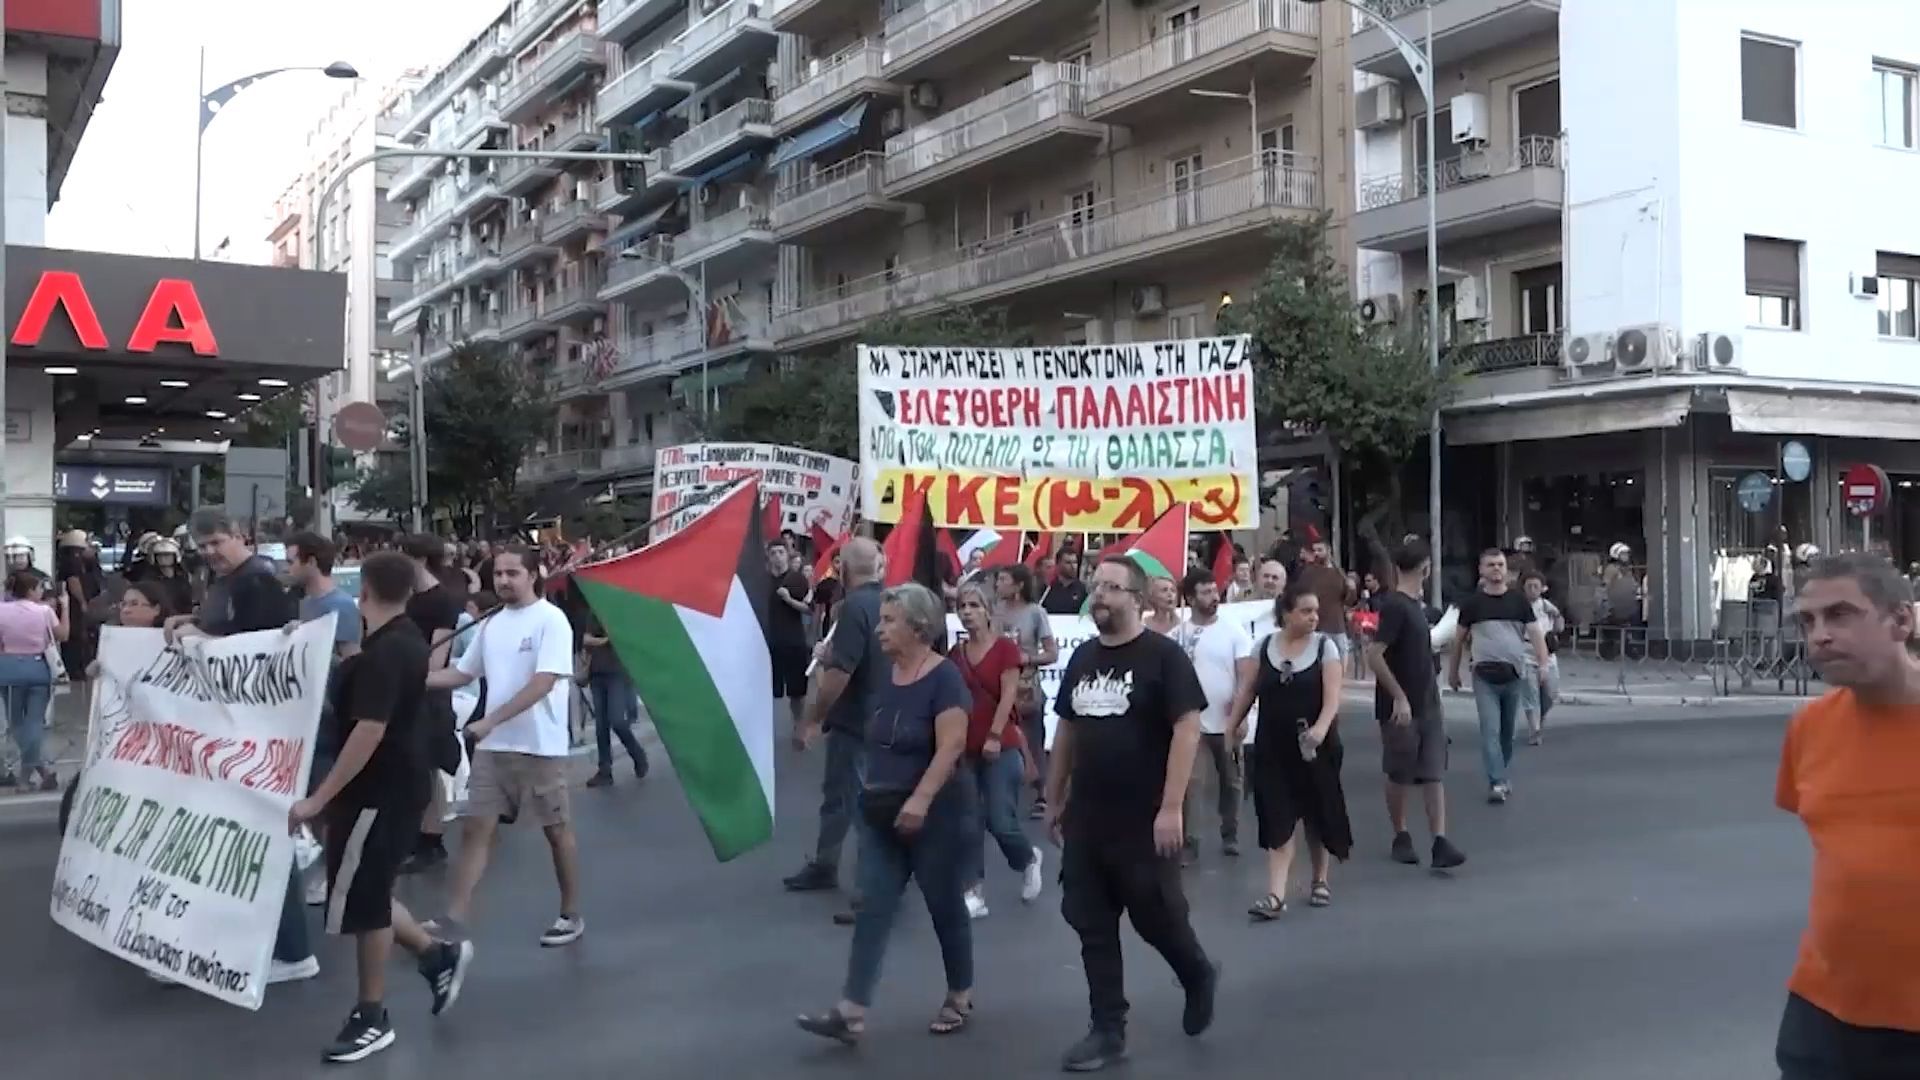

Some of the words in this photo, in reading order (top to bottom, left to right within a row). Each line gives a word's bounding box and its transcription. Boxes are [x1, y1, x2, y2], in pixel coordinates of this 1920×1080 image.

[868, 349, 891, 377] ΝΑ
[900, 346, 1007, 379] ΣΤΑΜΑΤΗΣΕΙ
[1015, 348, 1028, 376] Η
[1033, 342, 1145, 379] ΓΕΝΟΚΤΟΝΙΑ
[1154, 342, 1186, 376] ΣΤΗ
[1198, 338, 1252, 372] ΓΑΖΑ
[899, 387, 1041, 428] ΕΛΕΥΘΕΡΗ
[1055, 373, 1247, 429] ΠΑΛΑΙΣΤΙΝΗ
[870, 426, 896, 460] ΑΠΟ
[905, 429, 936, 463] ΤΟΝ
[944, 433, 1022, 467] ΠΟΤΑΜΟ
[1107, 427, 1226, 470] ΘΑΛΑΣΣΑ
